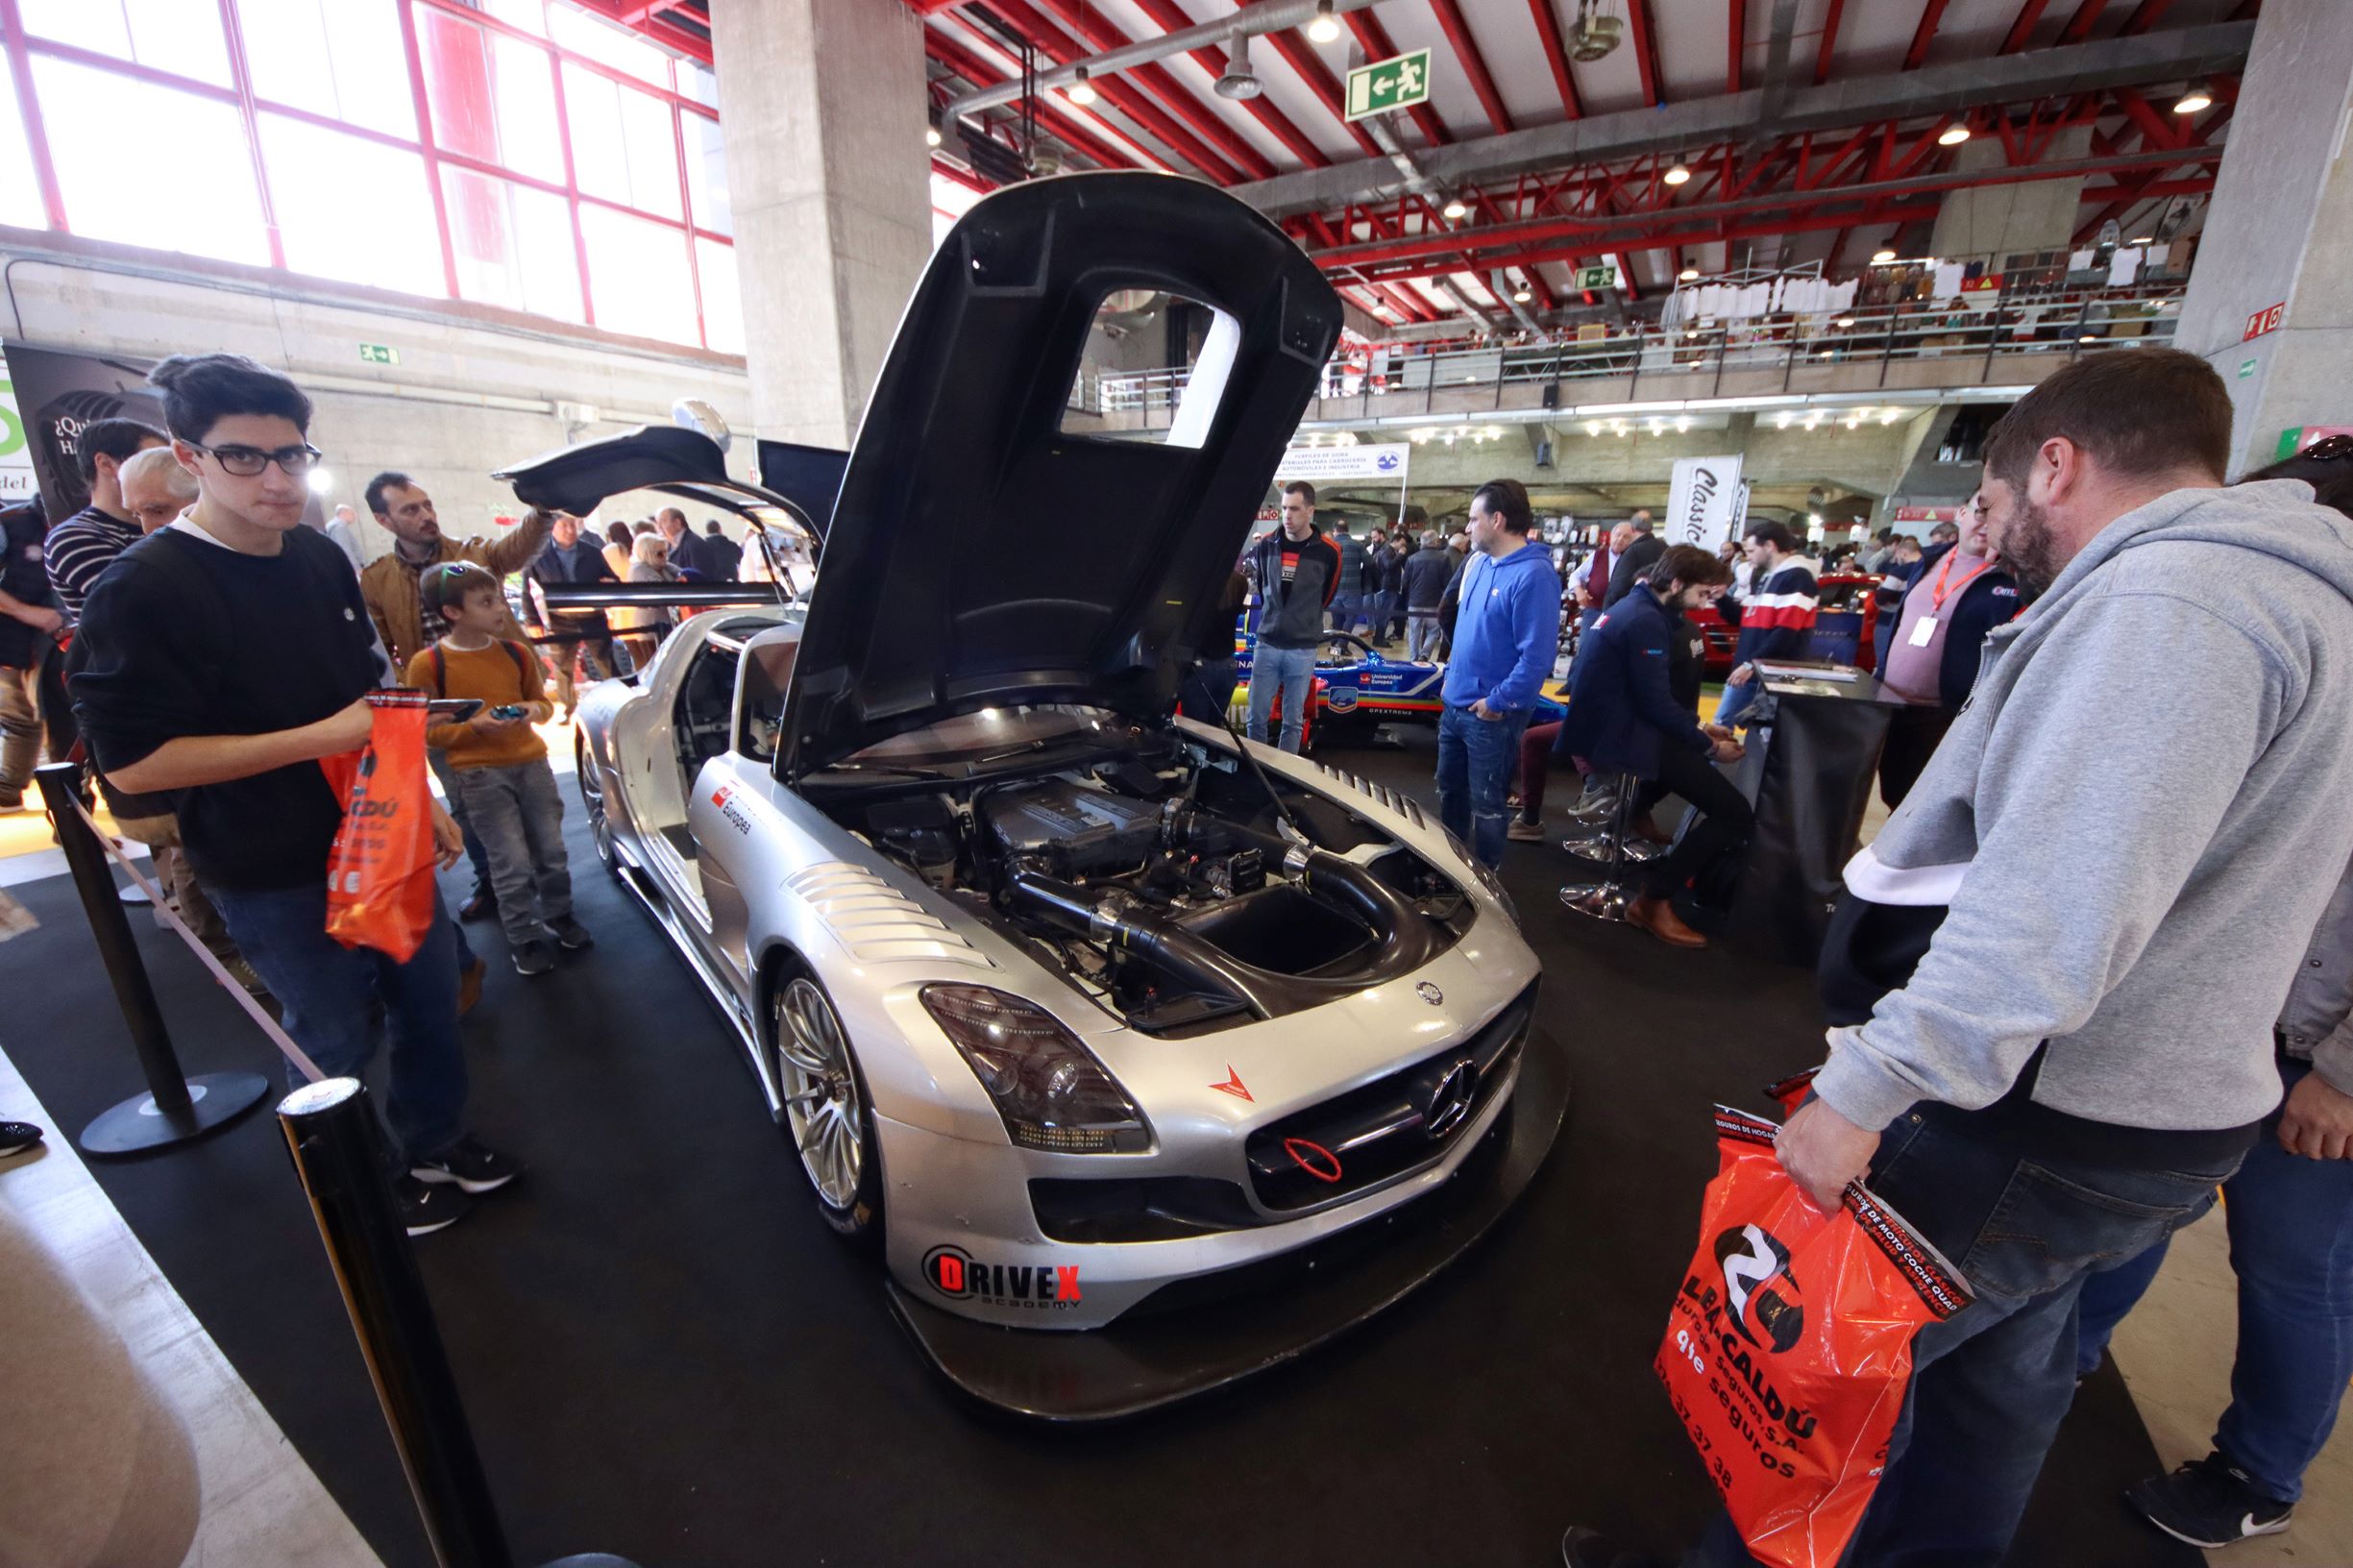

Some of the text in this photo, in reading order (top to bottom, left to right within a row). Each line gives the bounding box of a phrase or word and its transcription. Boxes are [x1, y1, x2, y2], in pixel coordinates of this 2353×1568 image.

[1686, 467, 1718, 546] Classic
[723, 801, 751, 835] Europea
[1846, 1184, 1871, 1211] GUROS
[1868, 1210, 1881, 1223] DE
[1878, 1223, 1904, 1251] MOTO
[1903, 1252, 1934, 1285] COCHE
[1931, 1286, 1958, 1311] QUAD
[1871, 1225, 1899, 1256] SALUD
[938, 1253, 1083, 1302] DRIVEX
[1694, 1424, 1712, 1452] 37
[1713, 1456, 1733, 1489] 38
[1710, 1377, 1797, 1479] seguros
